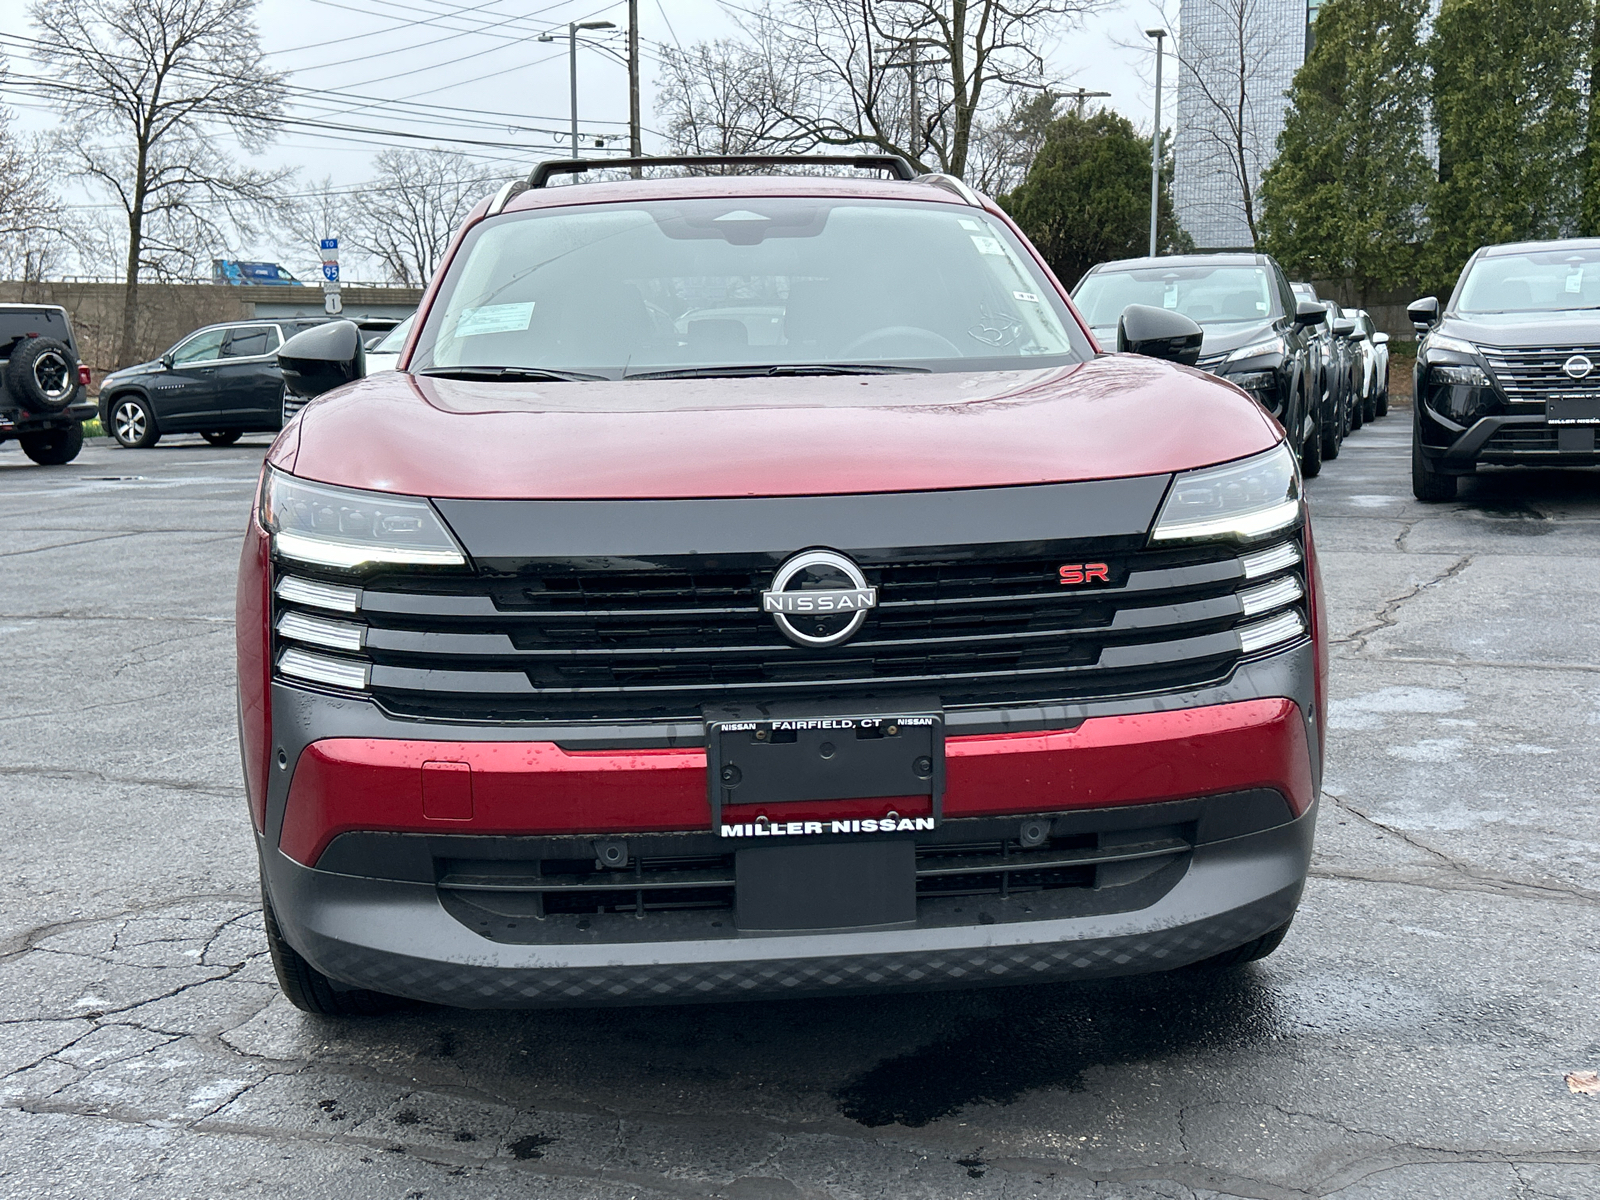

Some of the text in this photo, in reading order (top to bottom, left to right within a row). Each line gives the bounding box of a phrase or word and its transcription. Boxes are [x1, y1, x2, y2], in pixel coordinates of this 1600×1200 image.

[325, 267, 338, 278] 95
[1059, 562, 1110, 585] SR
[766, 592, 874, 611] NISSAN
[721, 723, 757, 731] NISSAN
[772, 719, 882, 730] FAIRFIELD, CT
[897, 718, 933, 726] NISSAN
[721, 818, 935, 838] MILLER NISSAN
